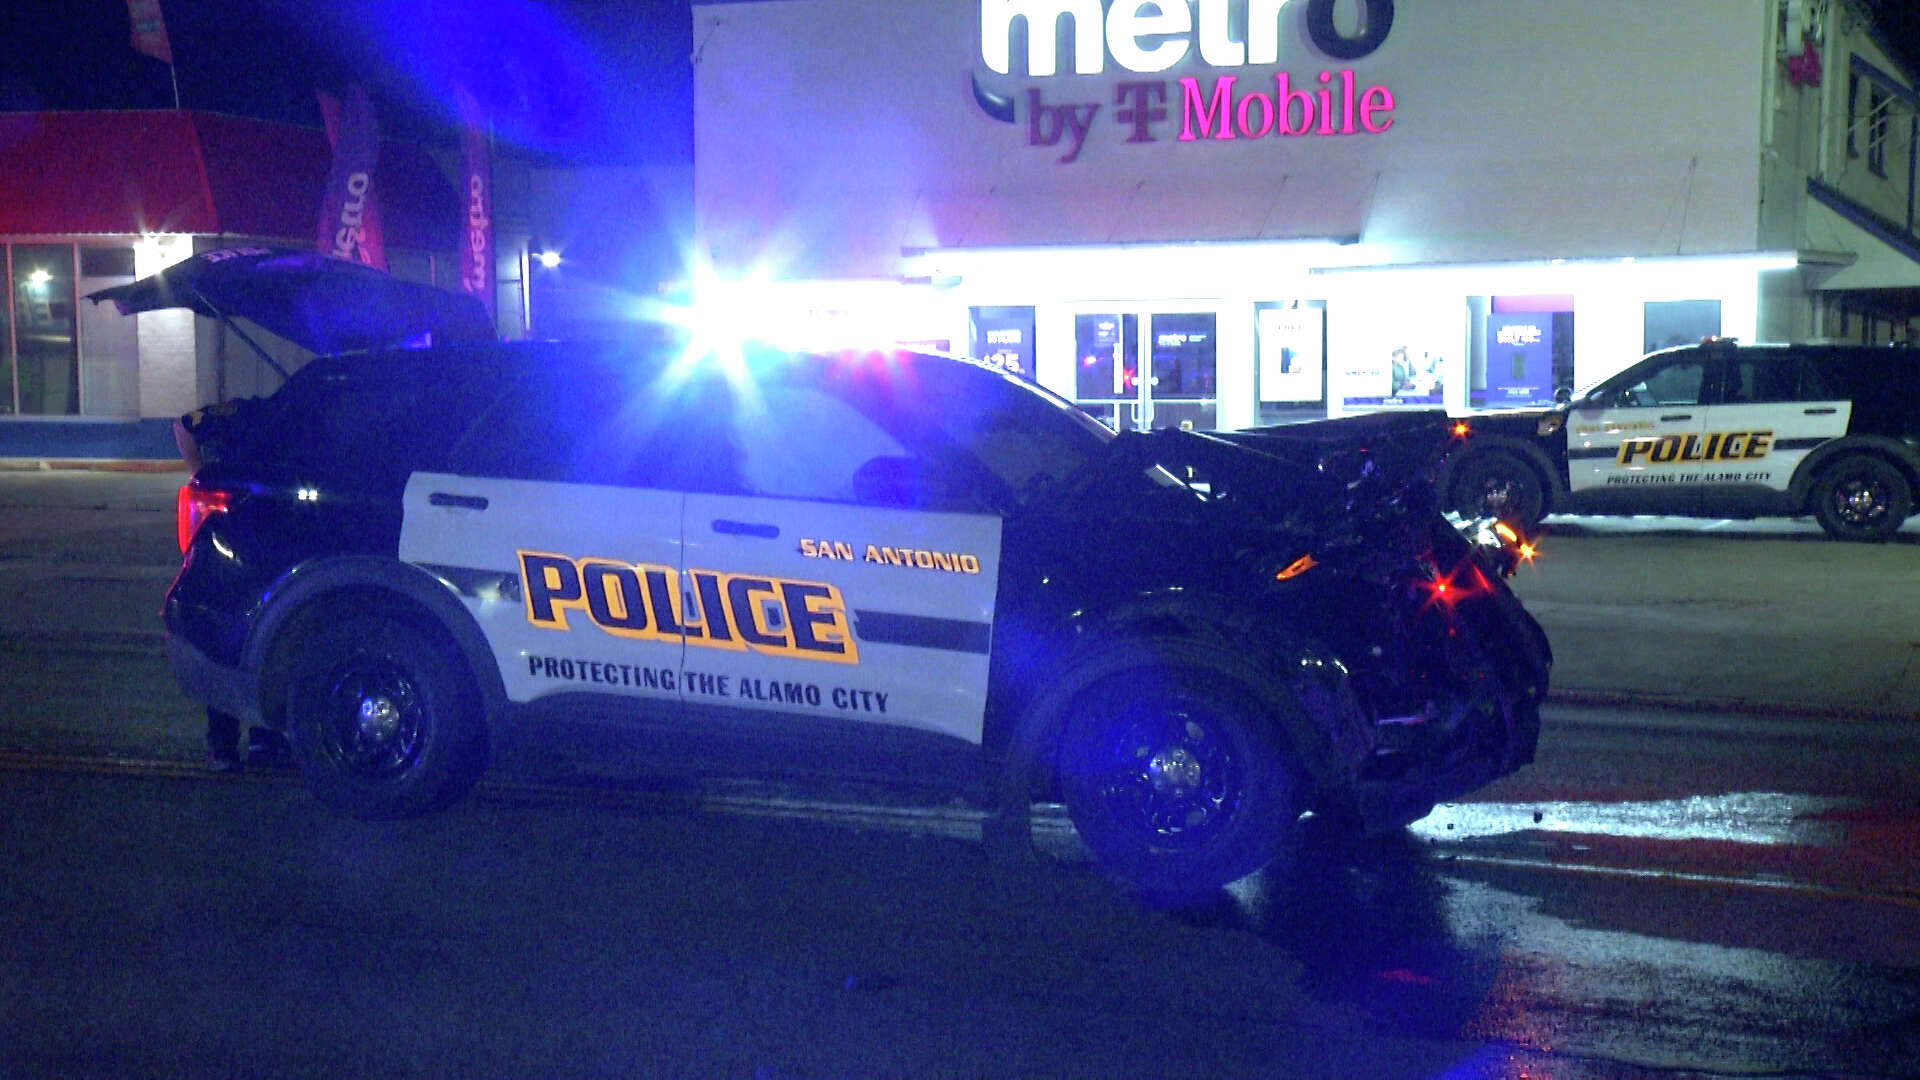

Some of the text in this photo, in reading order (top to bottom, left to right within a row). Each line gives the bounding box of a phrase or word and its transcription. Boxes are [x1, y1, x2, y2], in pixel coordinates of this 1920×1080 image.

[981, 0, 1395, 76] metro
[1027, 87, 1101, 164] by
[1606, 470, 1771, 484] PROTECTING THE ALAMO CITY
[1618, 431, 1774, 467] POLICE
[799, 538, 980, 575] SAN ANTONIO
[518, 550, 857, 663] POLICE
[528, 655, 888, 714] PROTECTING THE ALAMO CITY
